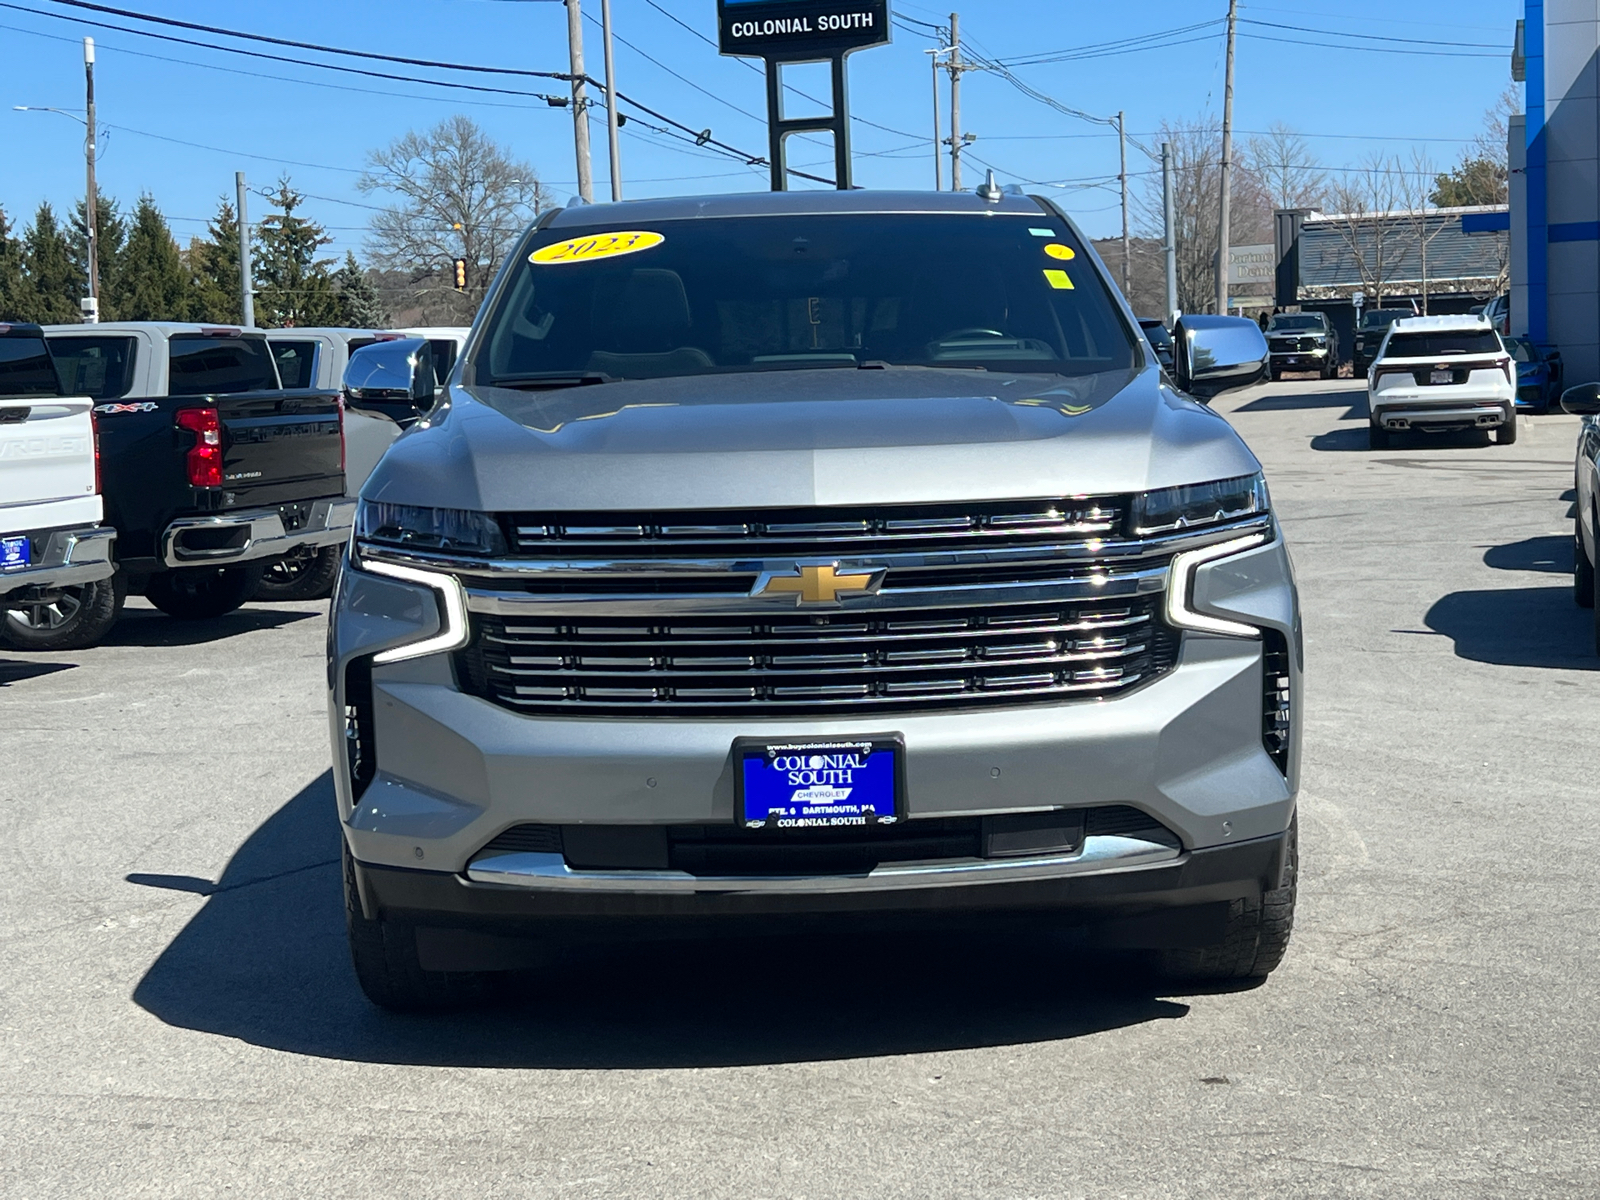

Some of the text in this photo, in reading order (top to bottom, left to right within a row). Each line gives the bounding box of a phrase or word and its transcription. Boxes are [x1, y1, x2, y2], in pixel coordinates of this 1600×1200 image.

[731, 12, 874, 38] COLONIAL SOUTH
[548, 234, 641, 261] 2023
[773, 753, 868, 772] COLONIAL
[788, 769, 854, 786] SOUTH
[797, 790, 845, 798] CHEVROLET
[803, 805, 859, 814] DARTMOUTH,
[777, 817, 866, 828] COLONIAL SOUTH
